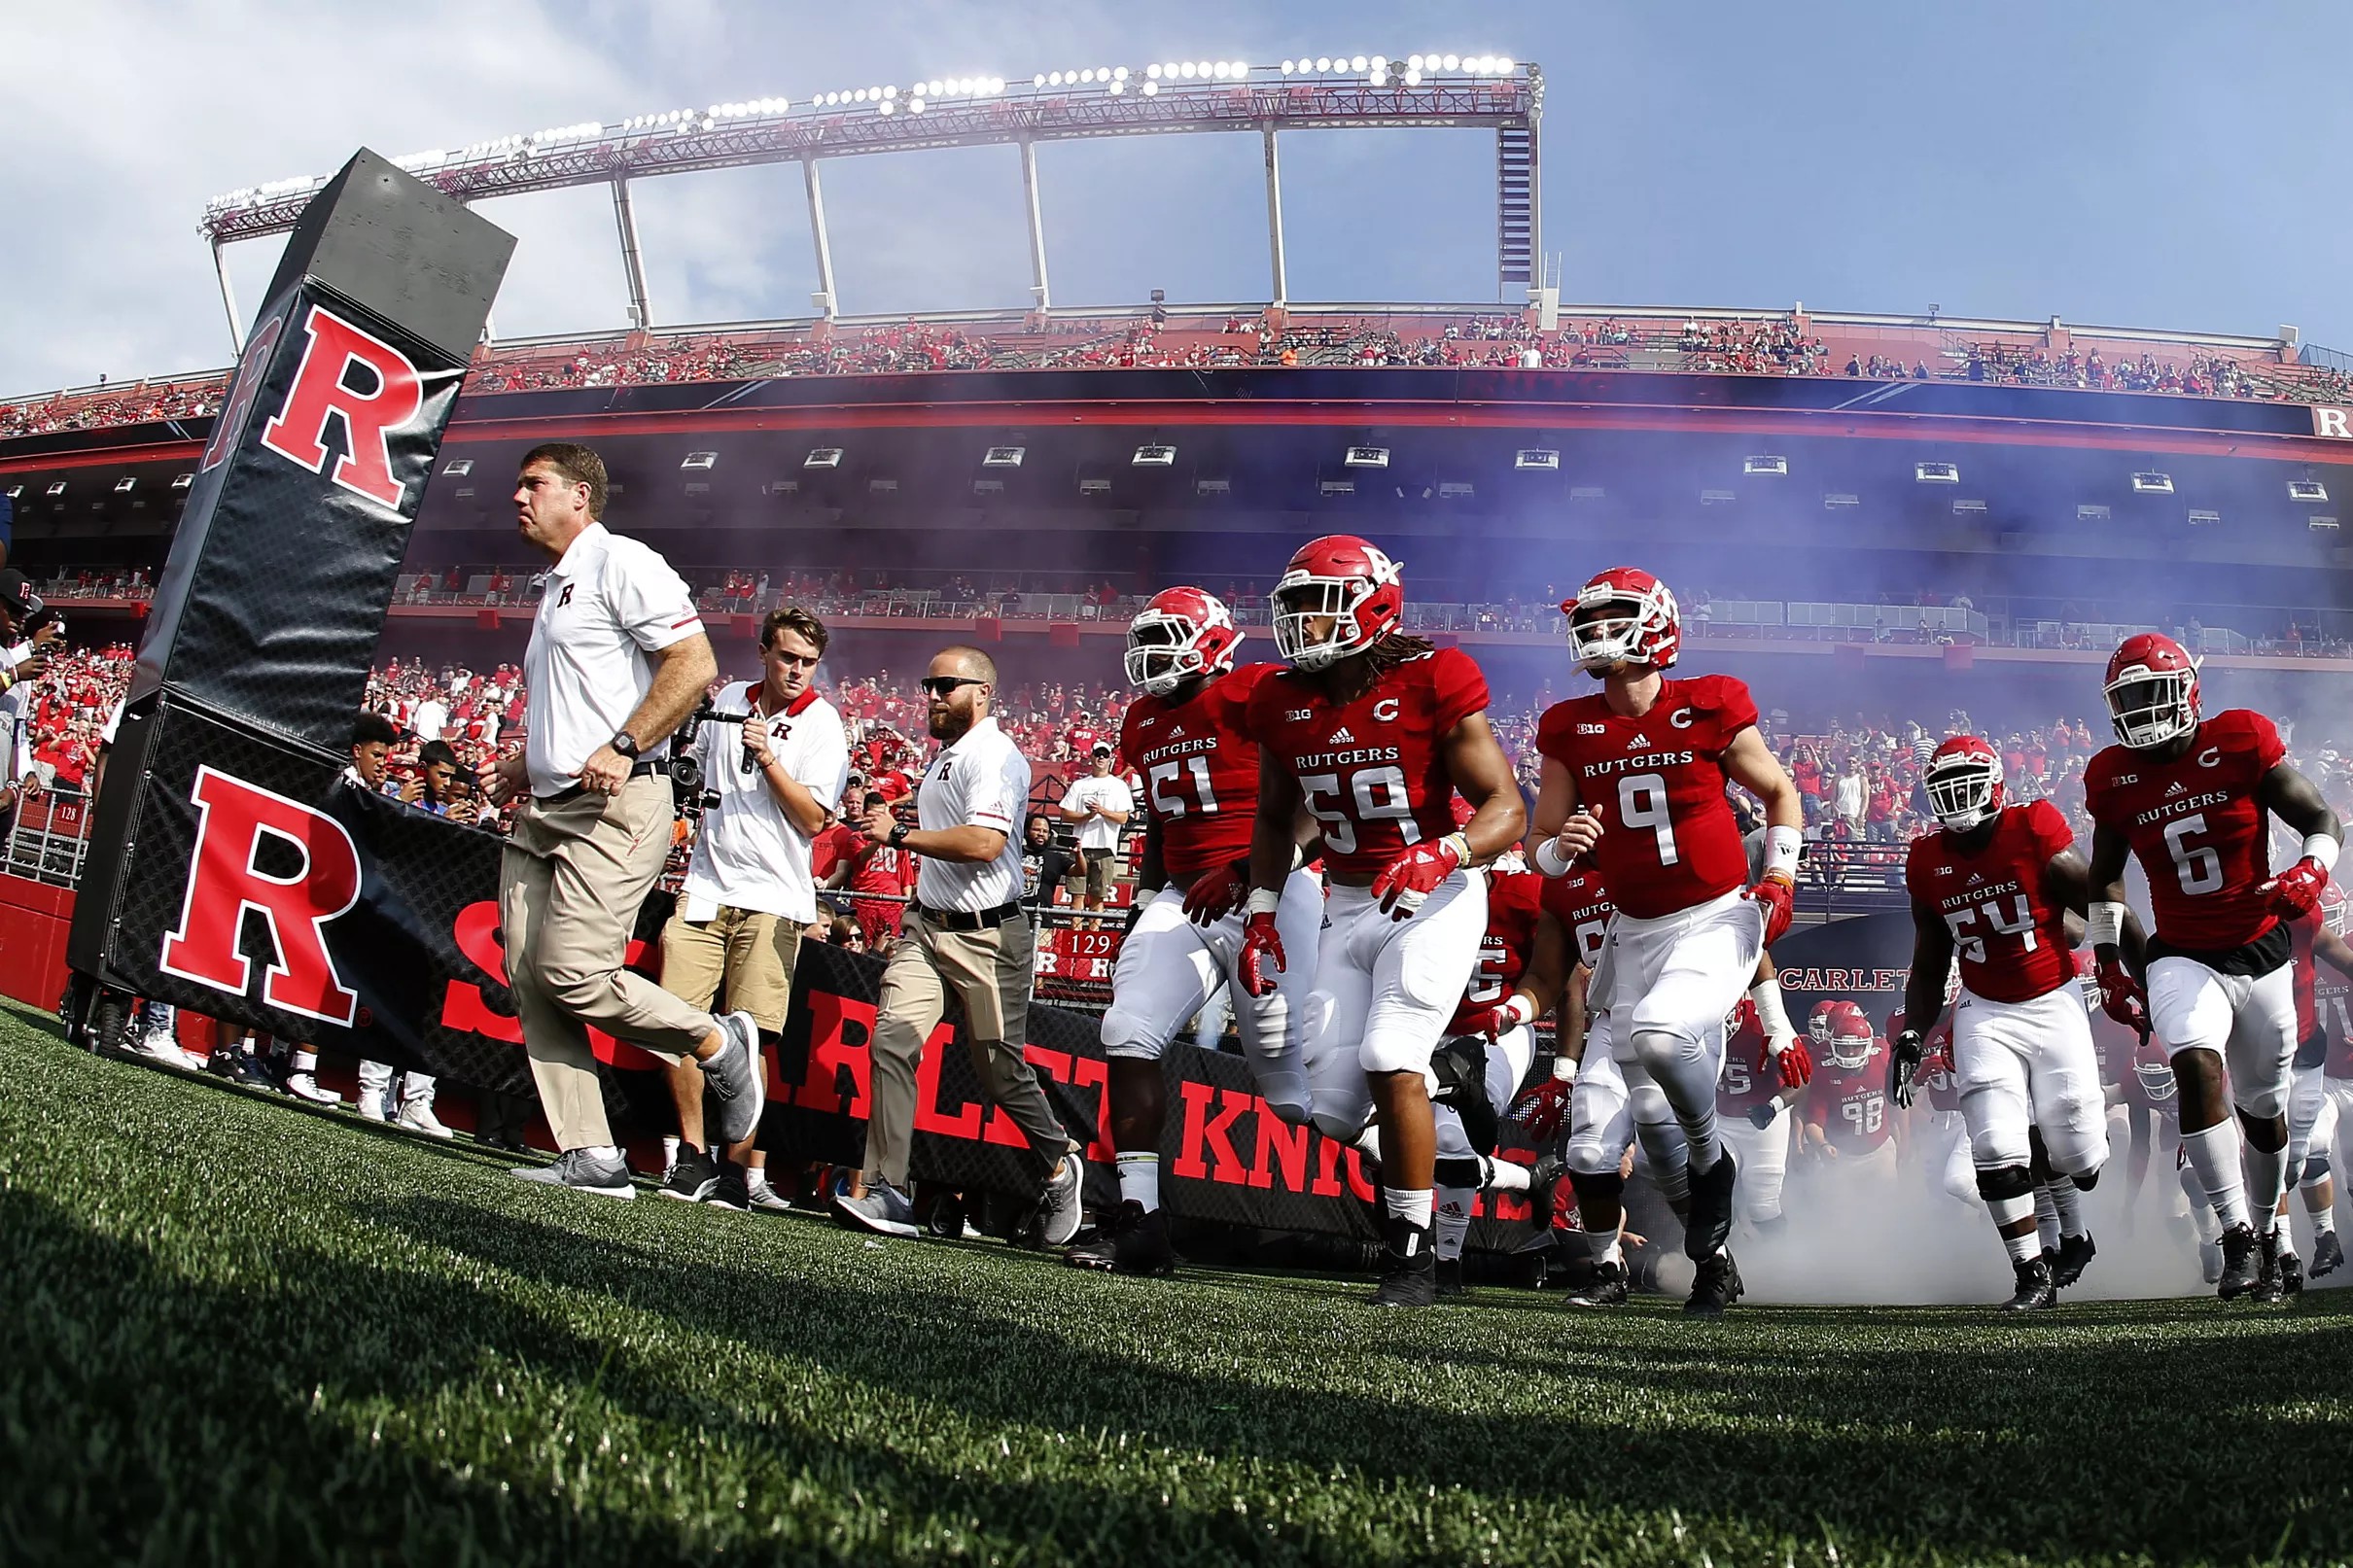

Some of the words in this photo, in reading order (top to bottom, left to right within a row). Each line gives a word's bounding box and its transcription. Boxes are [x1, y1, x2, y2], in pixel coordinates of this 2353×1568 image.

[260, 303, 424, 511] R
[2316, 407, 2353, 437] R
[556, 583, 575, 609] R
[1373, 698, 1399, 721] C
[1670, 707, 1693, 729] C
[771, 721, 792, 741] R
[1142, 737, 1218, 765] RUTGERS
[1295, 747, 1399, 769] RUTGERS
[1584, 750, 1694, 778] RUTGERS
[2197, 746, 2221, 768] C
[936, 761, 953, 782] R
[1149, 755, 1219, 817] 51
[61, 806, 77, 821] 128
[1298, 765, 1422, 854] 59
[1618, 773, 1679, 867] 9
[2136, 790, 2229, 825] RUTGERS
[2163, 813, 2224, 896] 6
[159, 763, 363, 1028] R
[1942, 881, 2018, 909] RUTGERS
[1944, 893, 2039, 964] 54
[1071, 934, 1110, 955] 129
[1036, 952, 1058, 973] R
[1842, 1097, 1885, 1136] 98
